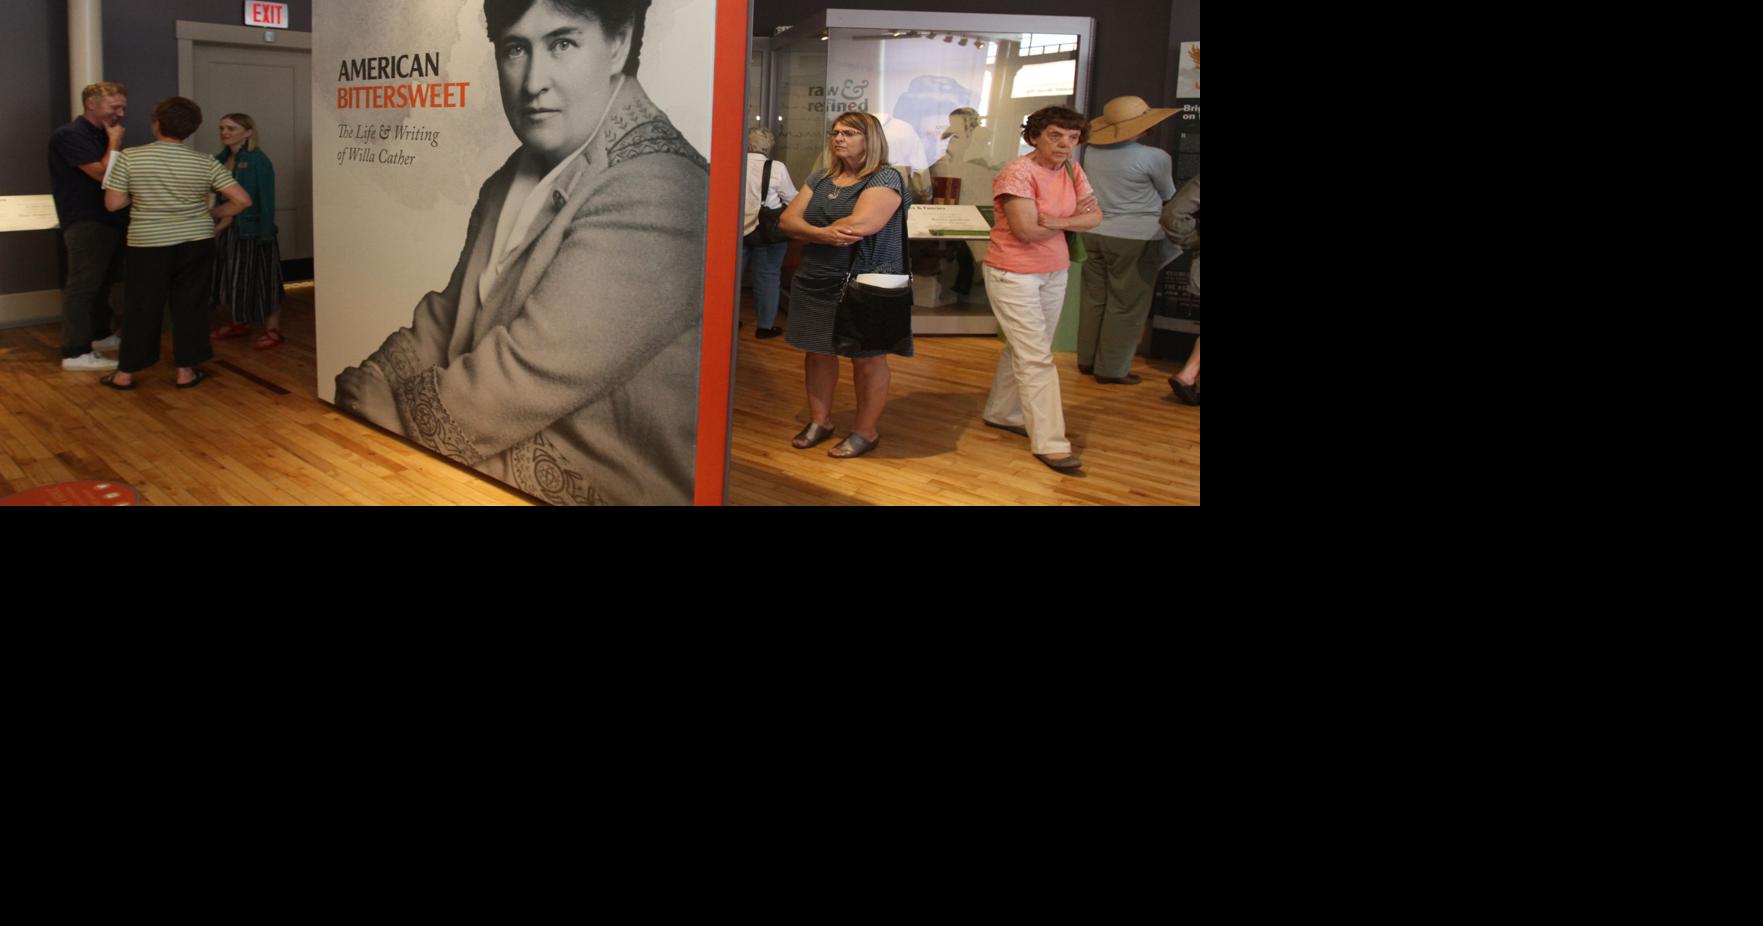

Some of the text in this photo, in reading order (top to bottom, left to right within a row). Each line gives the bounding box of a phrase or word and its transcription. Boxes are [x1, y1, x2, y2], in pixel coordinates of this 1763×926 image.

[252, 3, 283, 25] EXIT
[338, 51, 440, 82] AMERICAN
[337, 82, 470, 109] BITTERSWEET
[808, 79, 869, 101] raw &
[807, 98, 869, 113] refined
[338, 123, 441, 148] The Life & Writing
[337, 146, 416, 166] of Willa Cather
